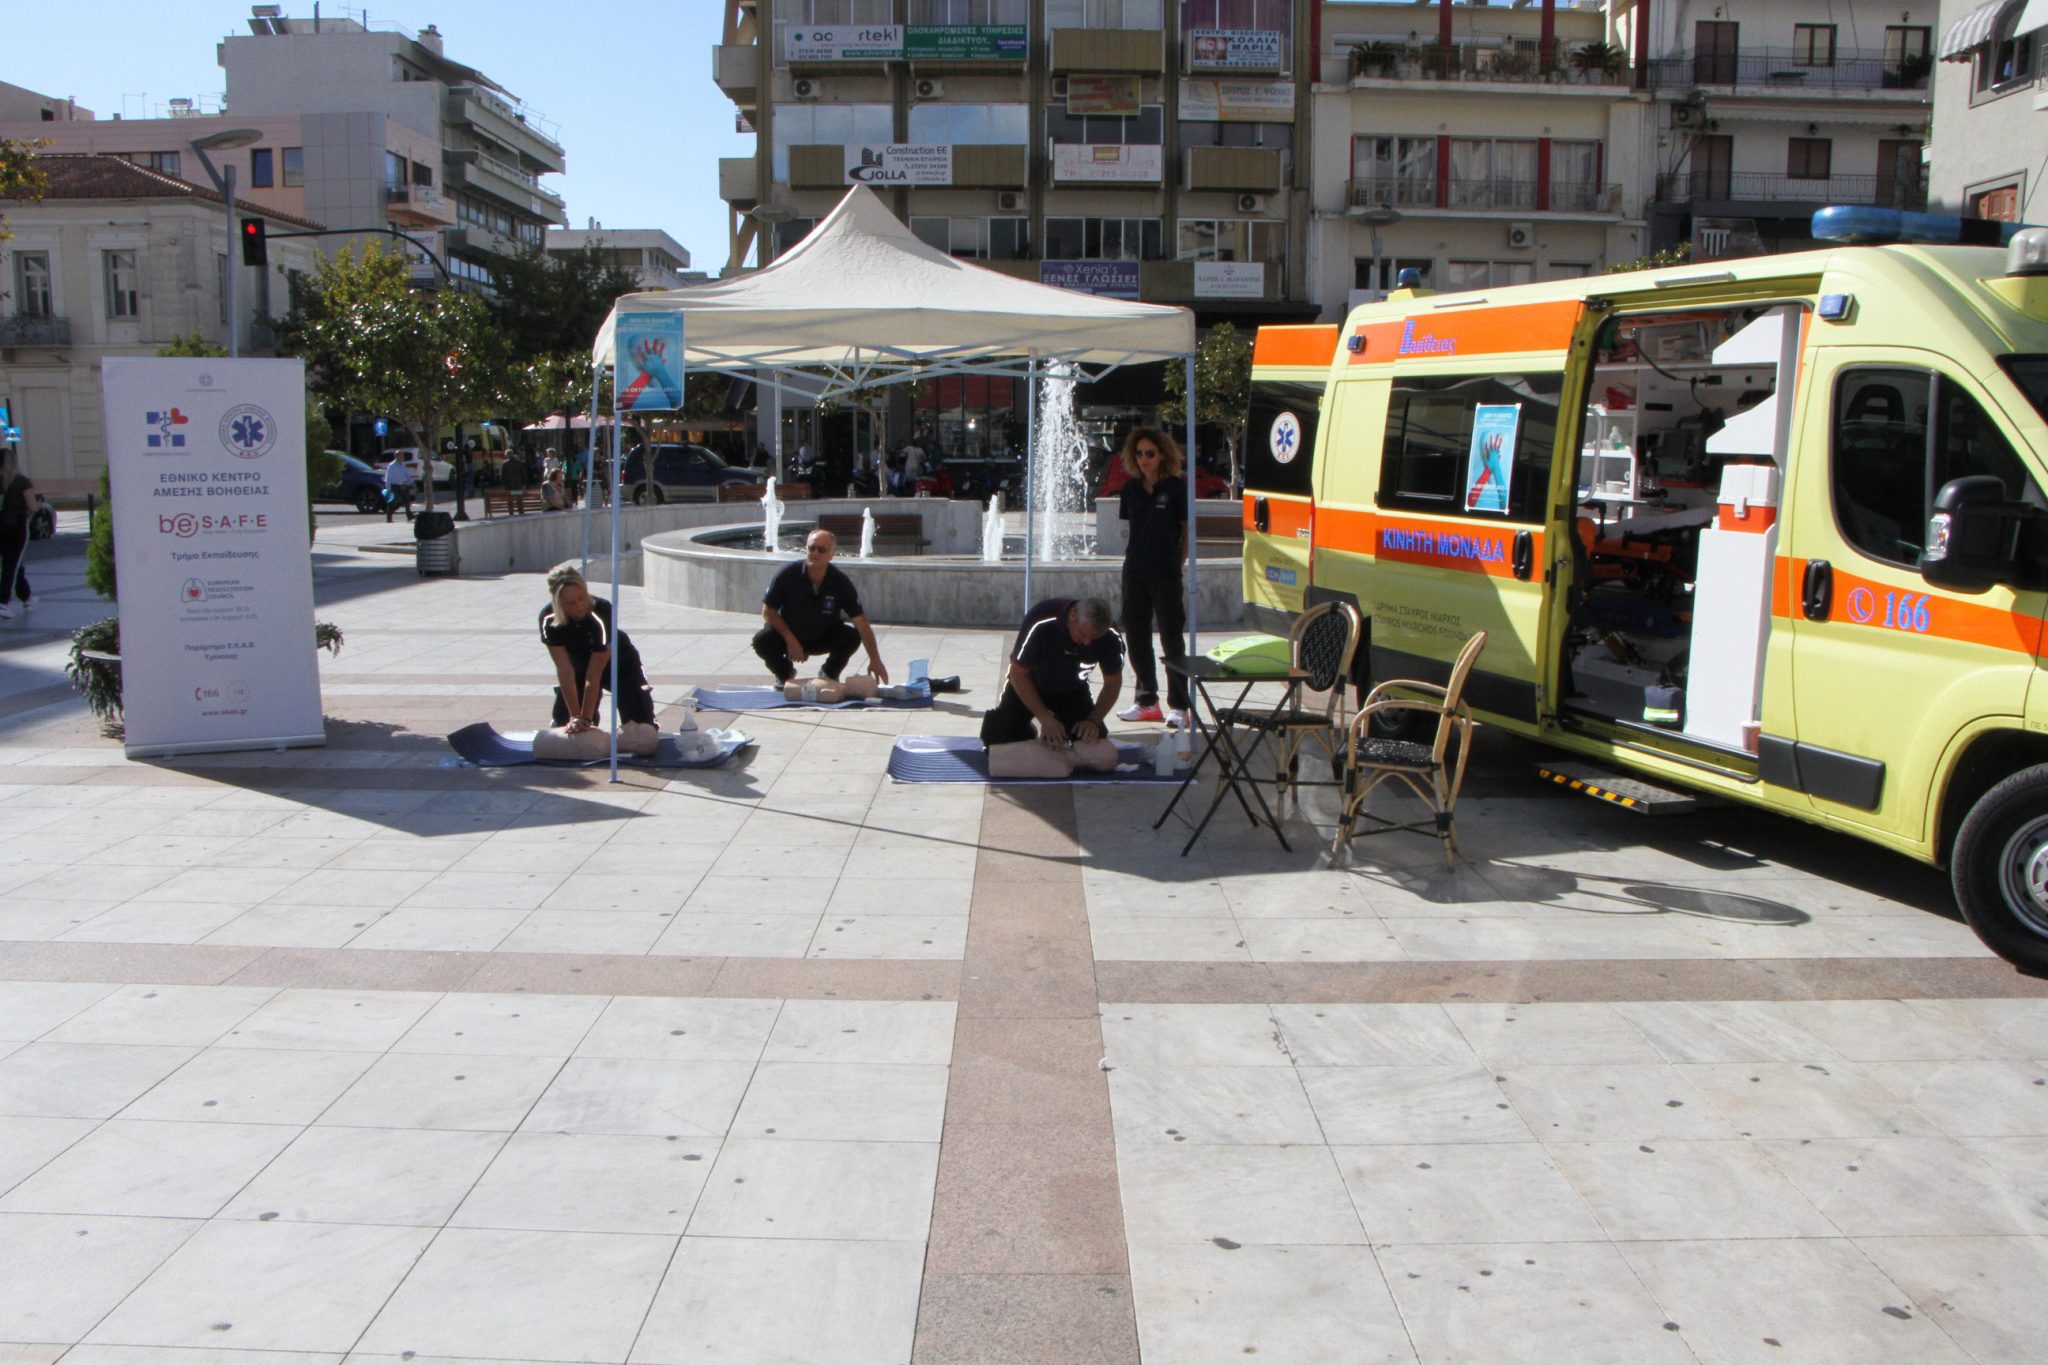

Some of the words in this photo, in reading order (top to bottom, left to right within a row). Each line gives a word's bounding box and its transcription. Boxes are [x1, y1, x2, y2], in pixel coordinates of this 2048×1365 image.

[907, 26, 976, 34] ΟΛΟΚΛΗΡΩΜΕΝΕΣ
[981, 26, 1025, 34] ΥΠΗΡΕΣΙΕΣ
[886, 146, 935, 155] Construction
[868, 171, 907, 180] JOLLA
[1075, 264, 1118, 274] Xenia's
[1043, 274, 1079, 283] ΞΕΝΕΣ
[1086, 275, 1138, 283] ΓΛΩΣΣΕΣ
[160, 473, 209, 483] ΕΘΝΙΚΟ
[212, 472, 262, 482] ΚΕΝΤΡΟ
[153, 487, 204, 497] ΑΜΕΣΗΣ
[207, 486, 270, 496] ΒΟΗΘΕΙΑΣ
[1383, 528, 1434, 554] ΚΙΝΗΤΗ
[1438, 533, 1505, 562] ΜΟΝΑΔΑ
[171, 552, 200, 561] Τμήμα
[202, 550, 260, 560] Εκπαίδευσης
[1399, 606, 1430, 620] ΣΤΑΥΡΟΣ
[1430, 612, 1461, 626] ΝΙΑΡΧΟΣ
[1883, 592, 1931, 632] 166
[1402, 620, 1438, 635] NIARCHOS
[202, 689, 220, 698] 166
